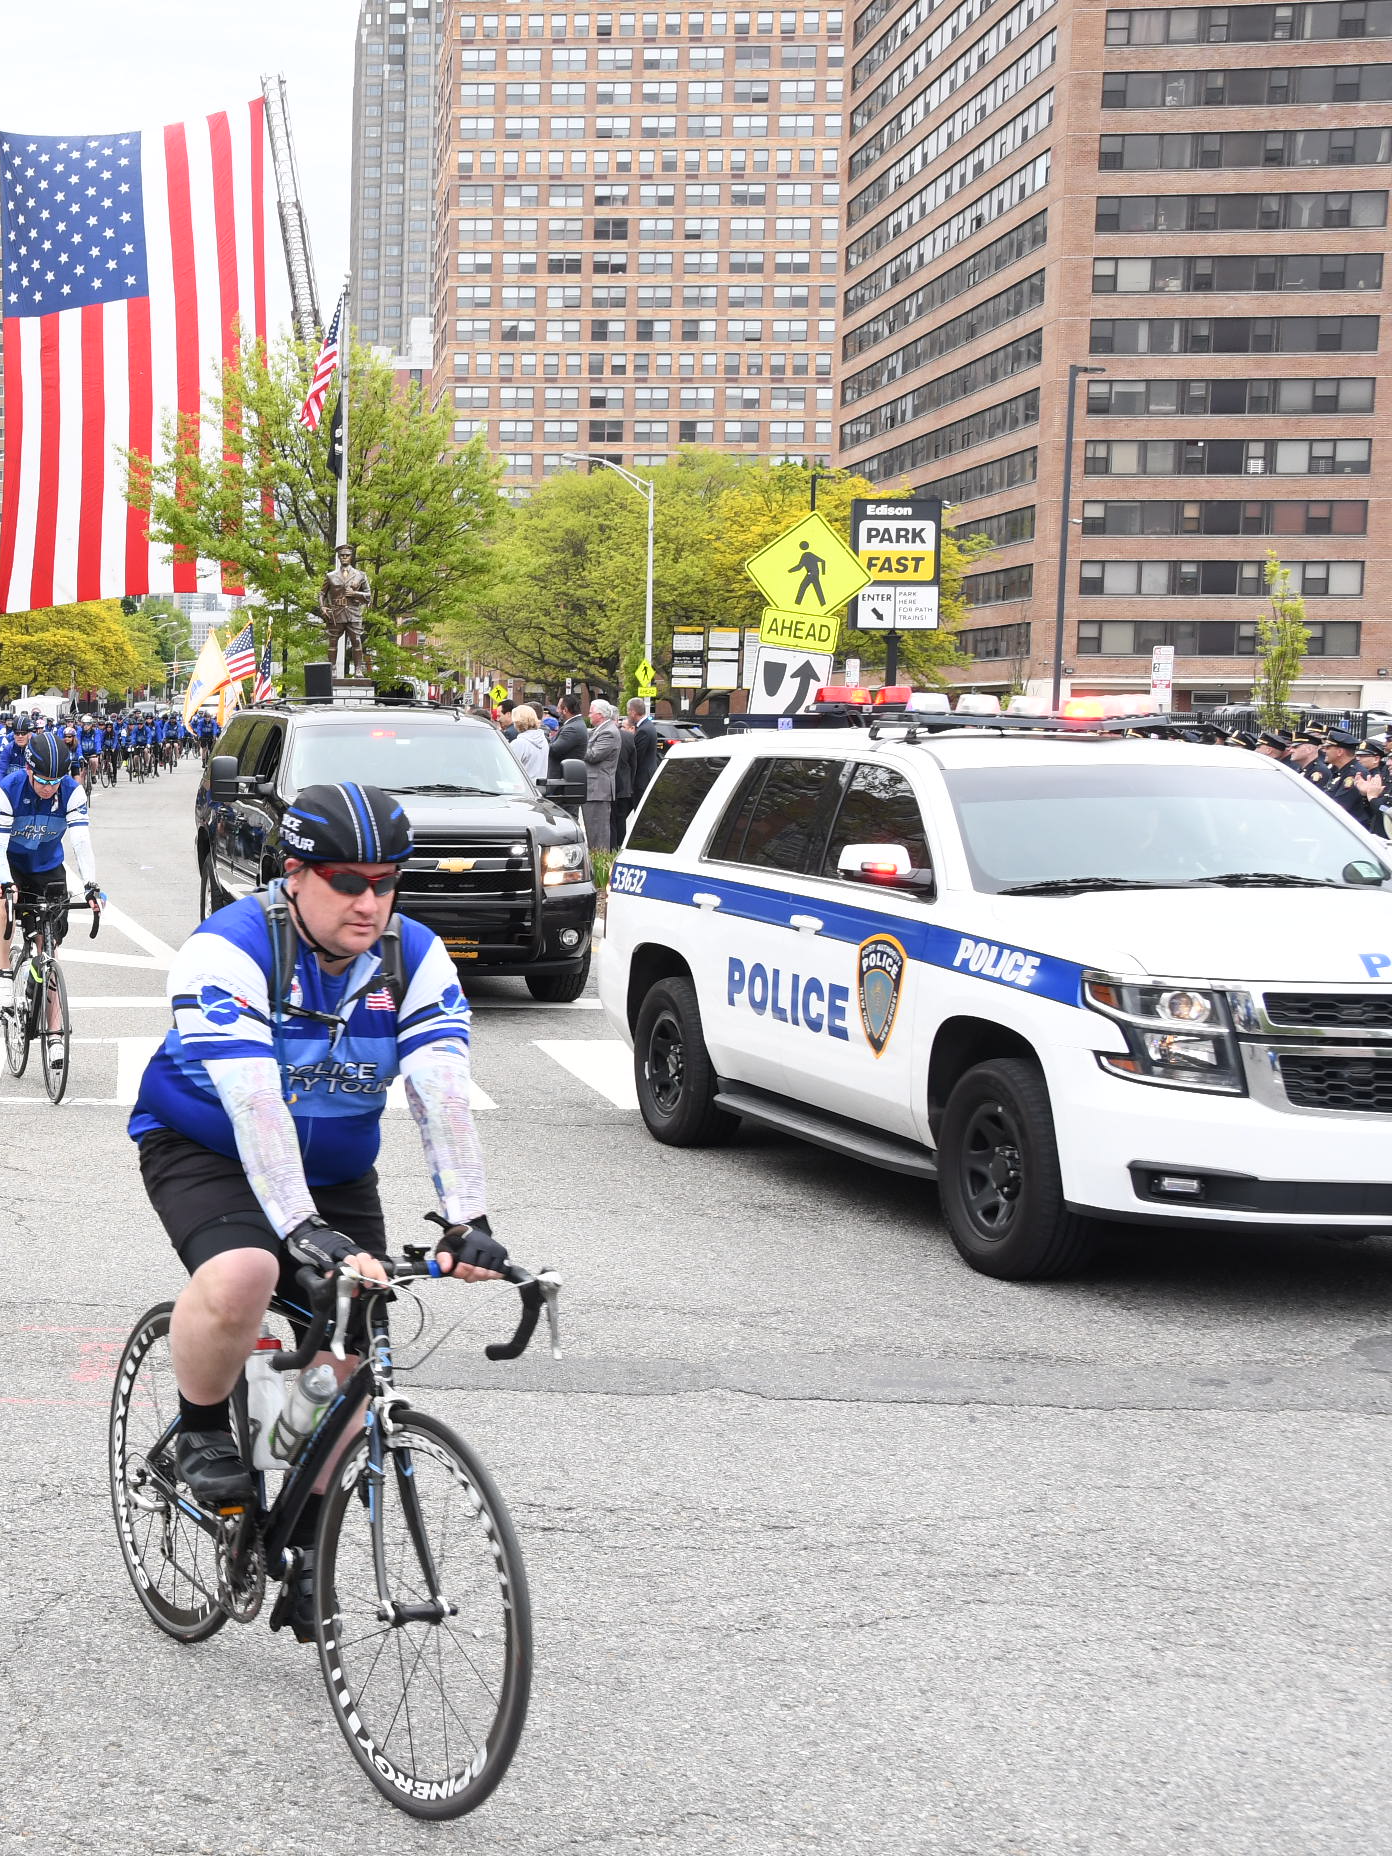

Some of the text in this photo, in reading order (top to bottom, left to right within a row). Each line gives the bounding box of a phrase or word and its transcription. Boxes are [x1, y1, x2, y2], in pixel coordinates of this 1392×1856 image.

[866, 504, 913, 516] Edison
[866, 527, 927, 544] PARK
[866, 556, 926, 574] FAST
[861, 593, 892, 602] ENTER
[767, 617, 831, 643] AHEAD
[613, 866, 647, 894] 53632
[862, 952, 899, 980] POLICE
[953, 937, 1042, 987] POLICE
[728, 957, 850, 1042] POLICE
[357, 1736, 488, 1801] SPINERGY
